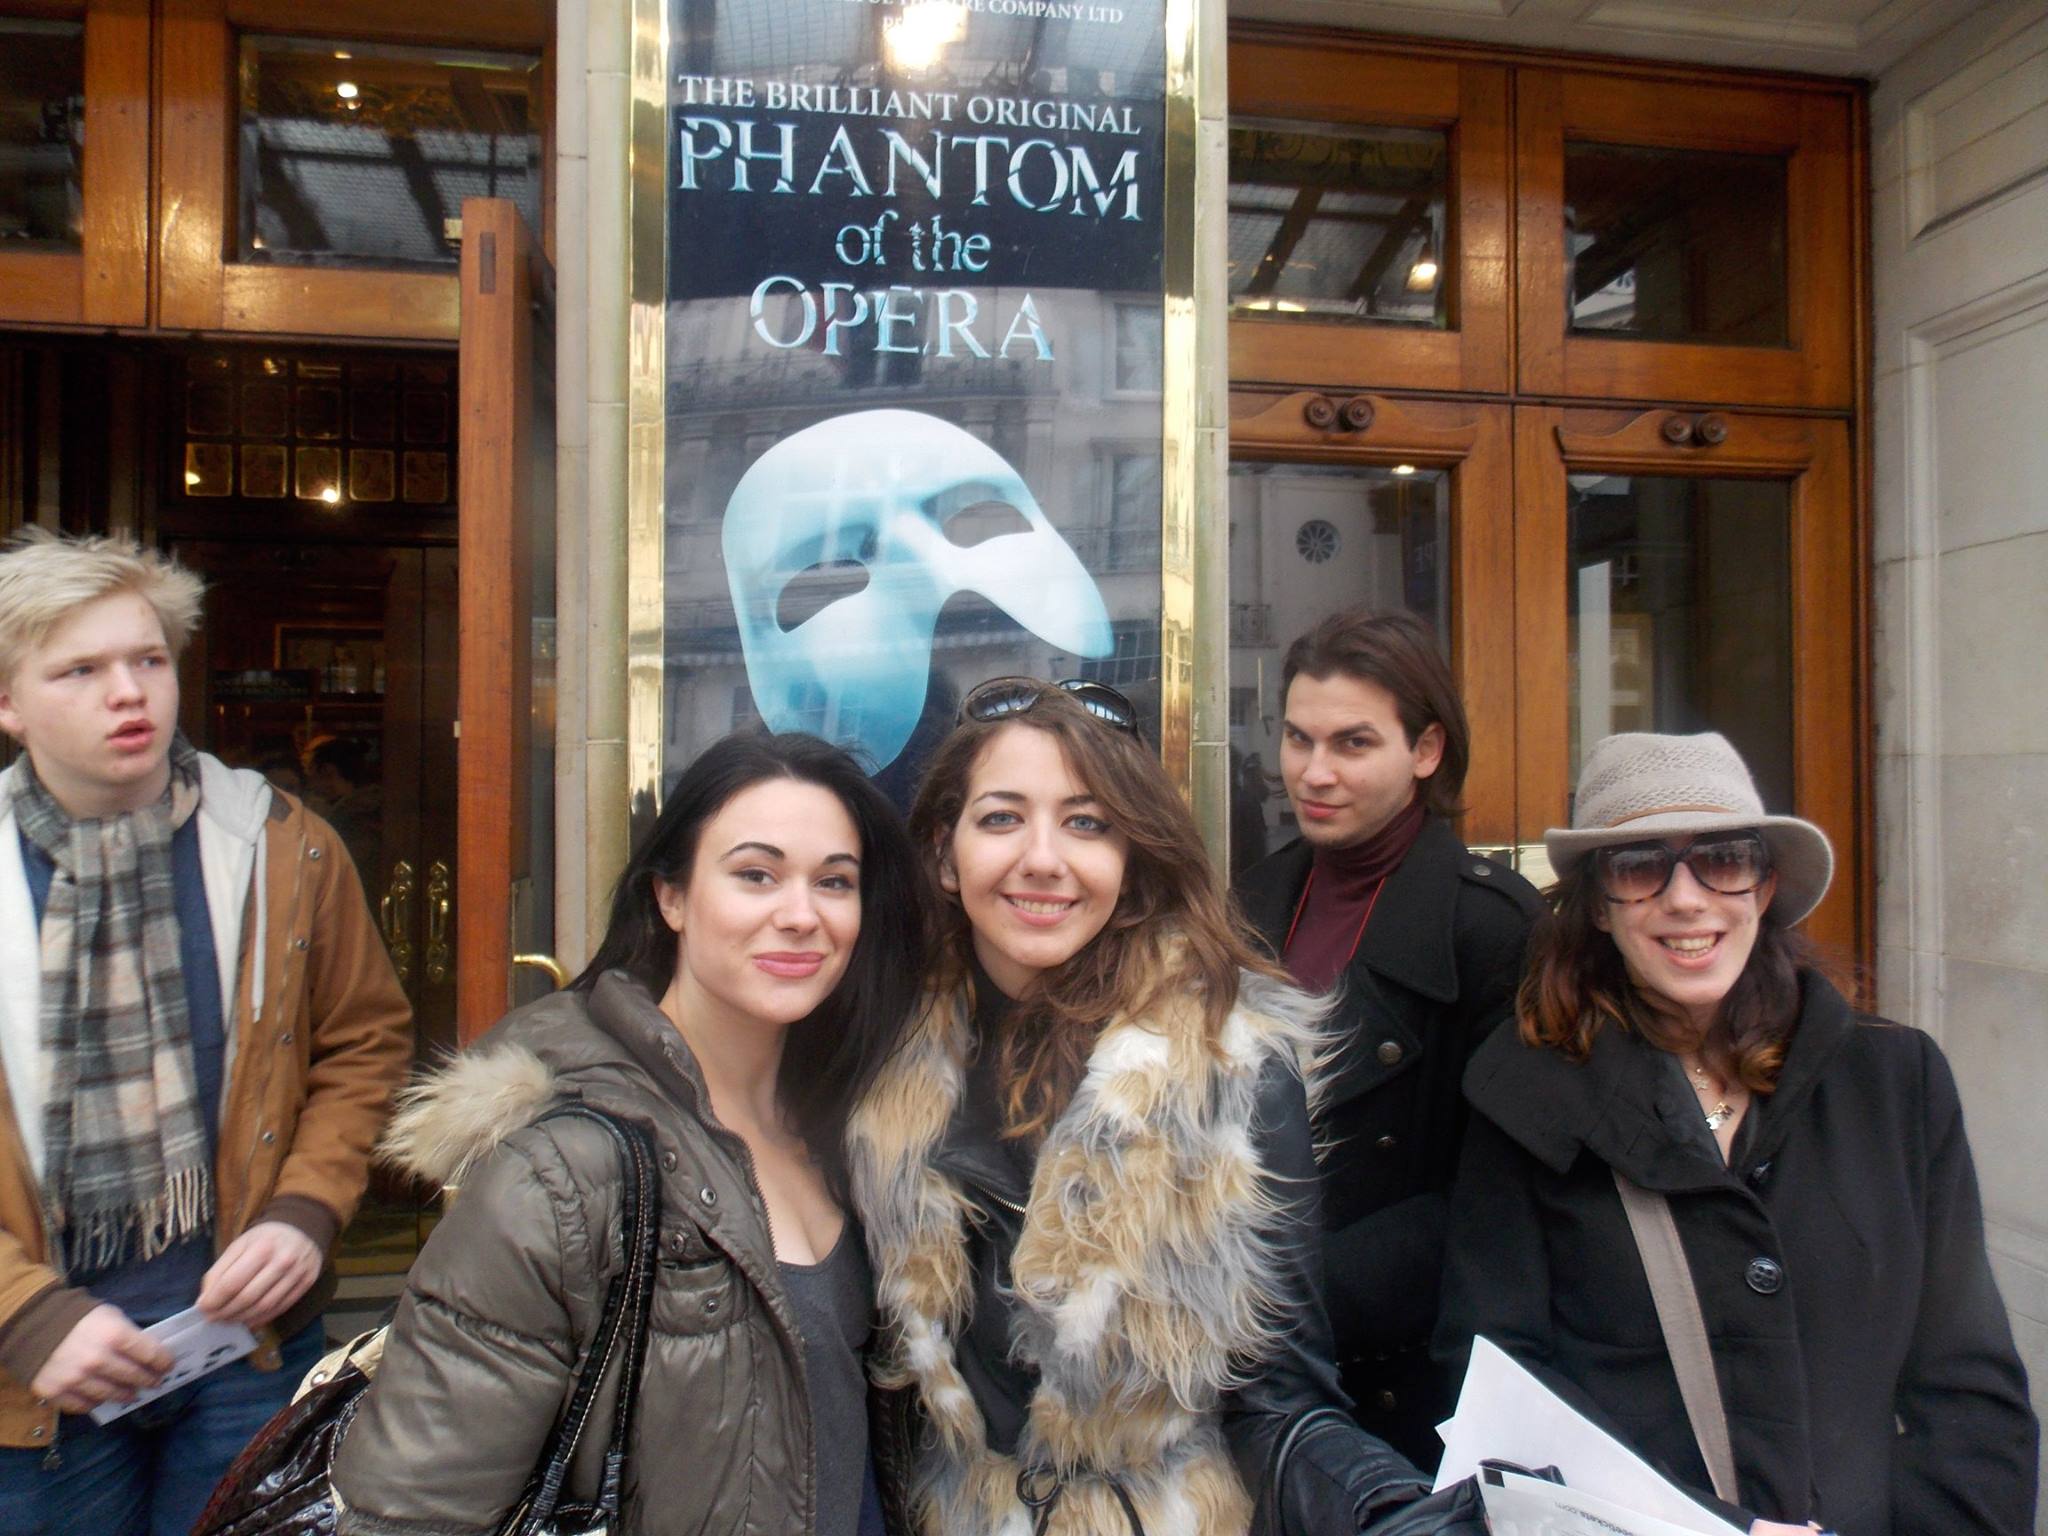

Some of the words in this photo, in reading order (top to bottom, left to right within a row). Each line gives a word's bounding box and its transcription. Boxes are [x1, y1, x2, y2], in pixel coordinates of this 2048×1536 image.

[988, 0, 1084, 20] COMPANY
[1088, 6, 1124, 23] LTD
[678, 75, 756, 107] THE
[765, 81, 958, 122] BRILLIANT
[966, 96, 1142, 135] ORIGINAL
[678, 115, 1143, 221] PHANTOM
[835, 209, 899, 265] of
[906, 214, 992, 272] the
[750, 275, 1055, 361] OPERA
